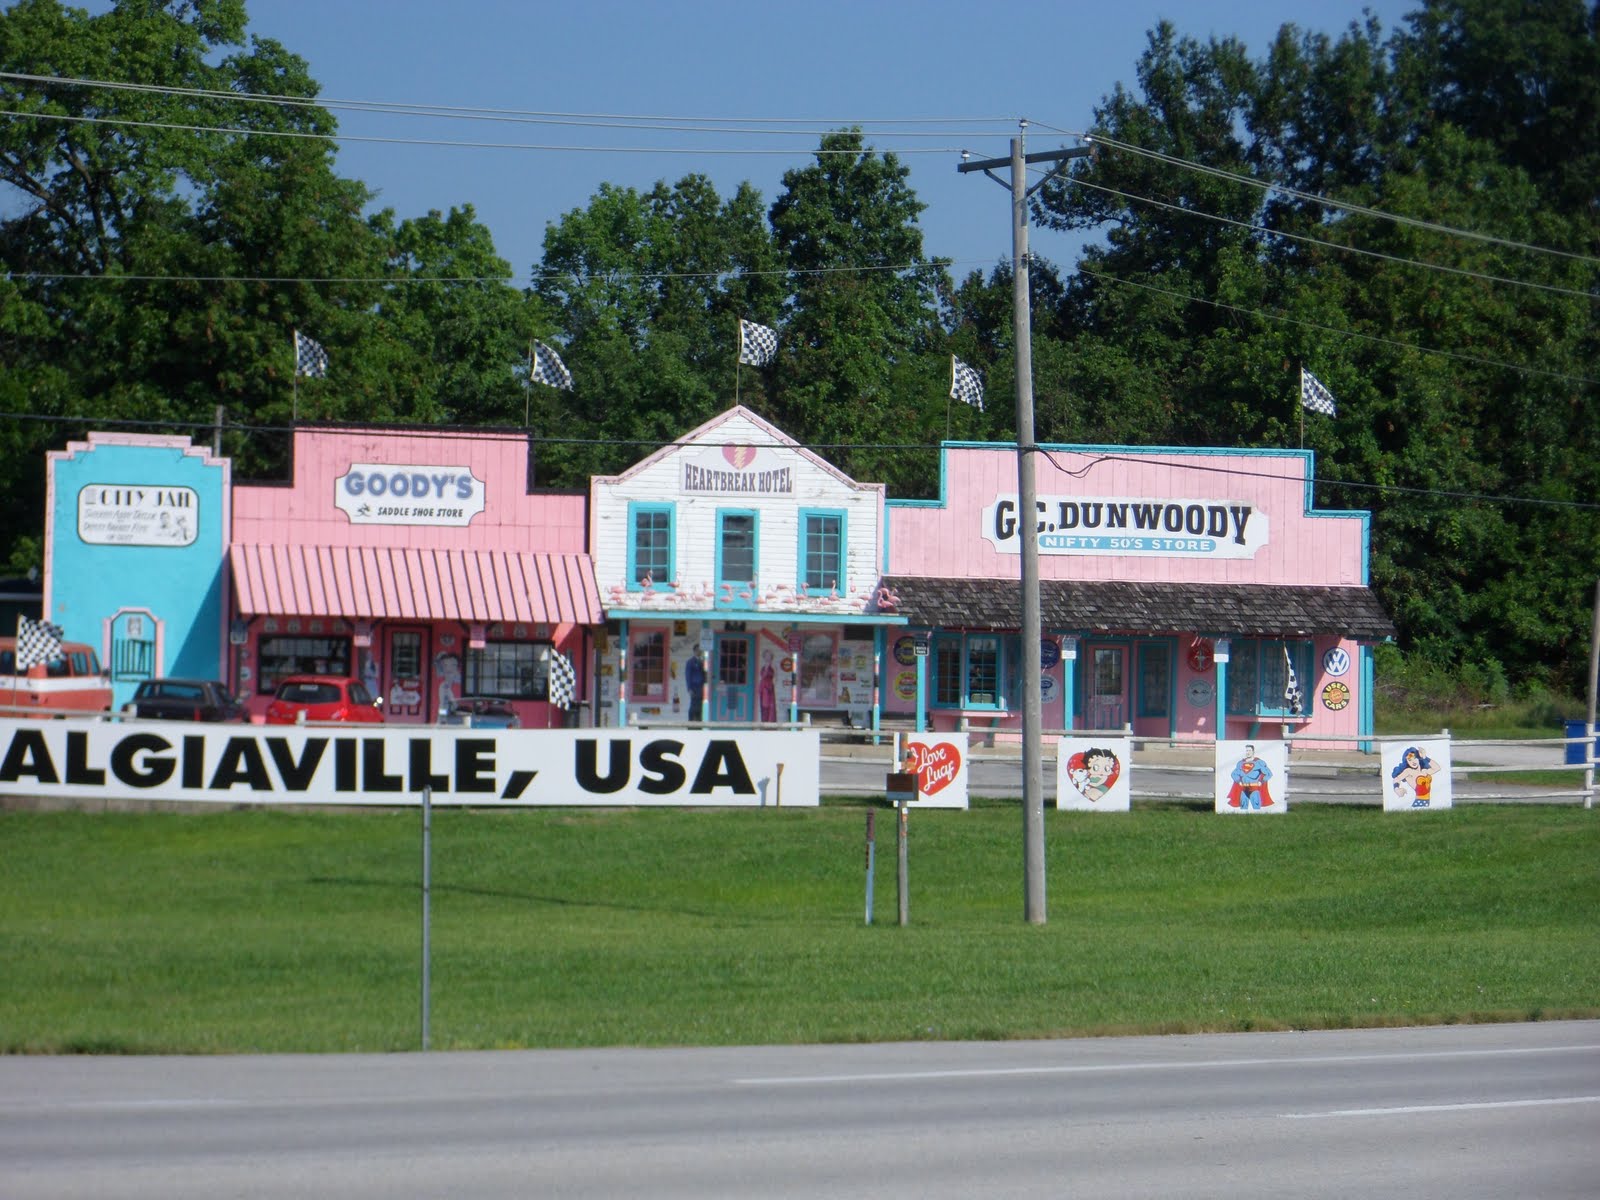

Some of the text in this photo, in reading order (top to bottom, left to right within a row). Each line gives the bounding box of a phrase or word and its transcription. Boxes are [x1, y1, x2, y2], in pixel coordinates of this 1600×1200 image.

[344, 471, 473, 499] GOODY'S
[685, 463, 792, 493] HEARTBREAK HOTEL
[101, 489, 190, 507] CITY JAIL
[378, 506, 463, 518] SADDLE SHOE STORE
[1045, 537, 1211, 551] NIFTY 50'S STORE
[1325, 682, 1347, 692] USED
[1325, 699, 1347, 710] CARS
[0, 729, 757, 799] ALGIAVILLE, USA
[917, 747, 947, 773] Love
[923, 760, 954, 792] Lucy
